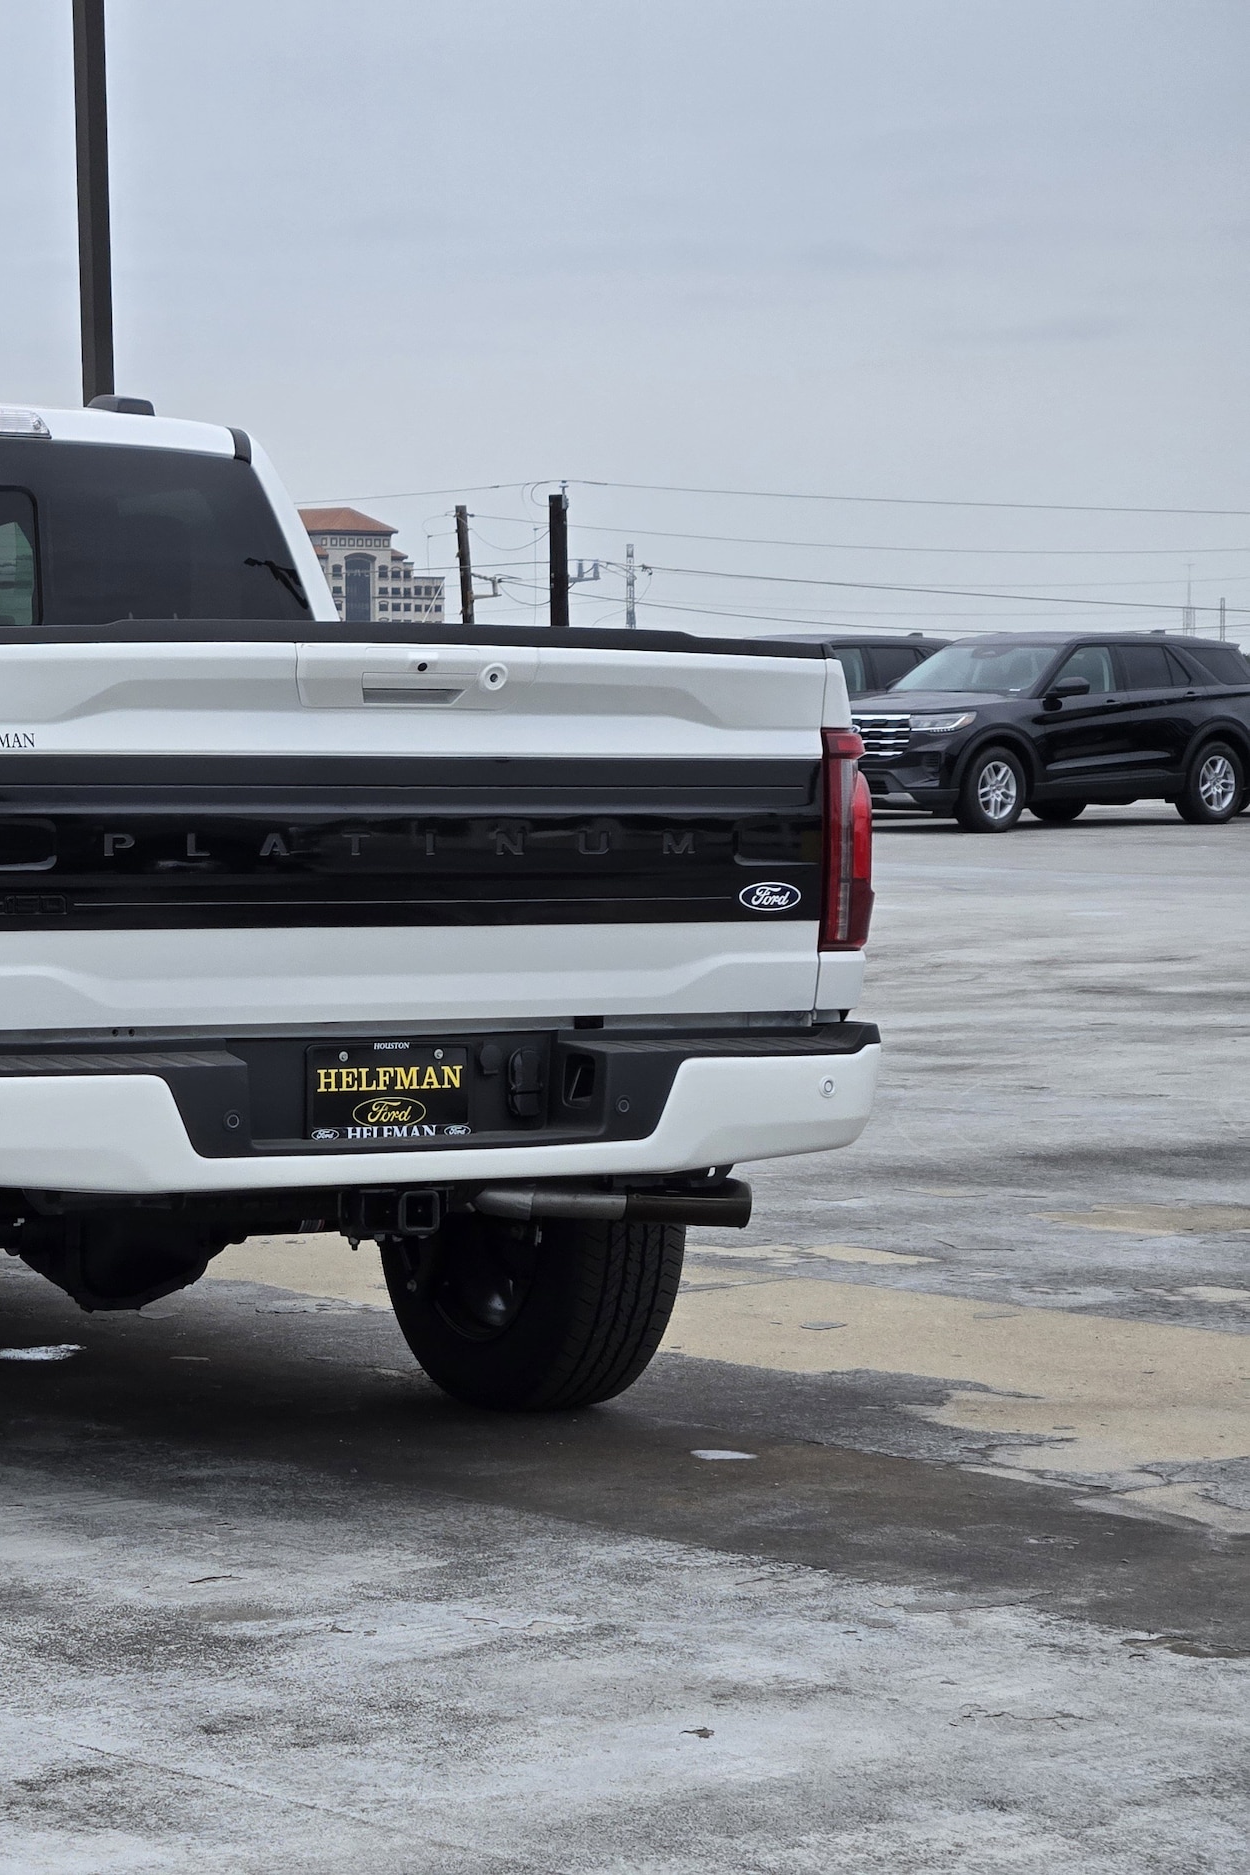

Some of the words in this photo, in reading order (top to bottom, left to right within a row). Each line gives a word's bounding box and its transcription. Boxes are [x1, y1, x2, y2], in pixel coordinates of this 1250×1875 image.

[103, 831, 696, 857] PLATINUM
[750, 886, 790, 907] Ford
[373, 1042, 410, 1050] HOUSTON
[316, 1065, 463, 1093] HELFMAN
[367, 1100, 413, 1123] Ford
